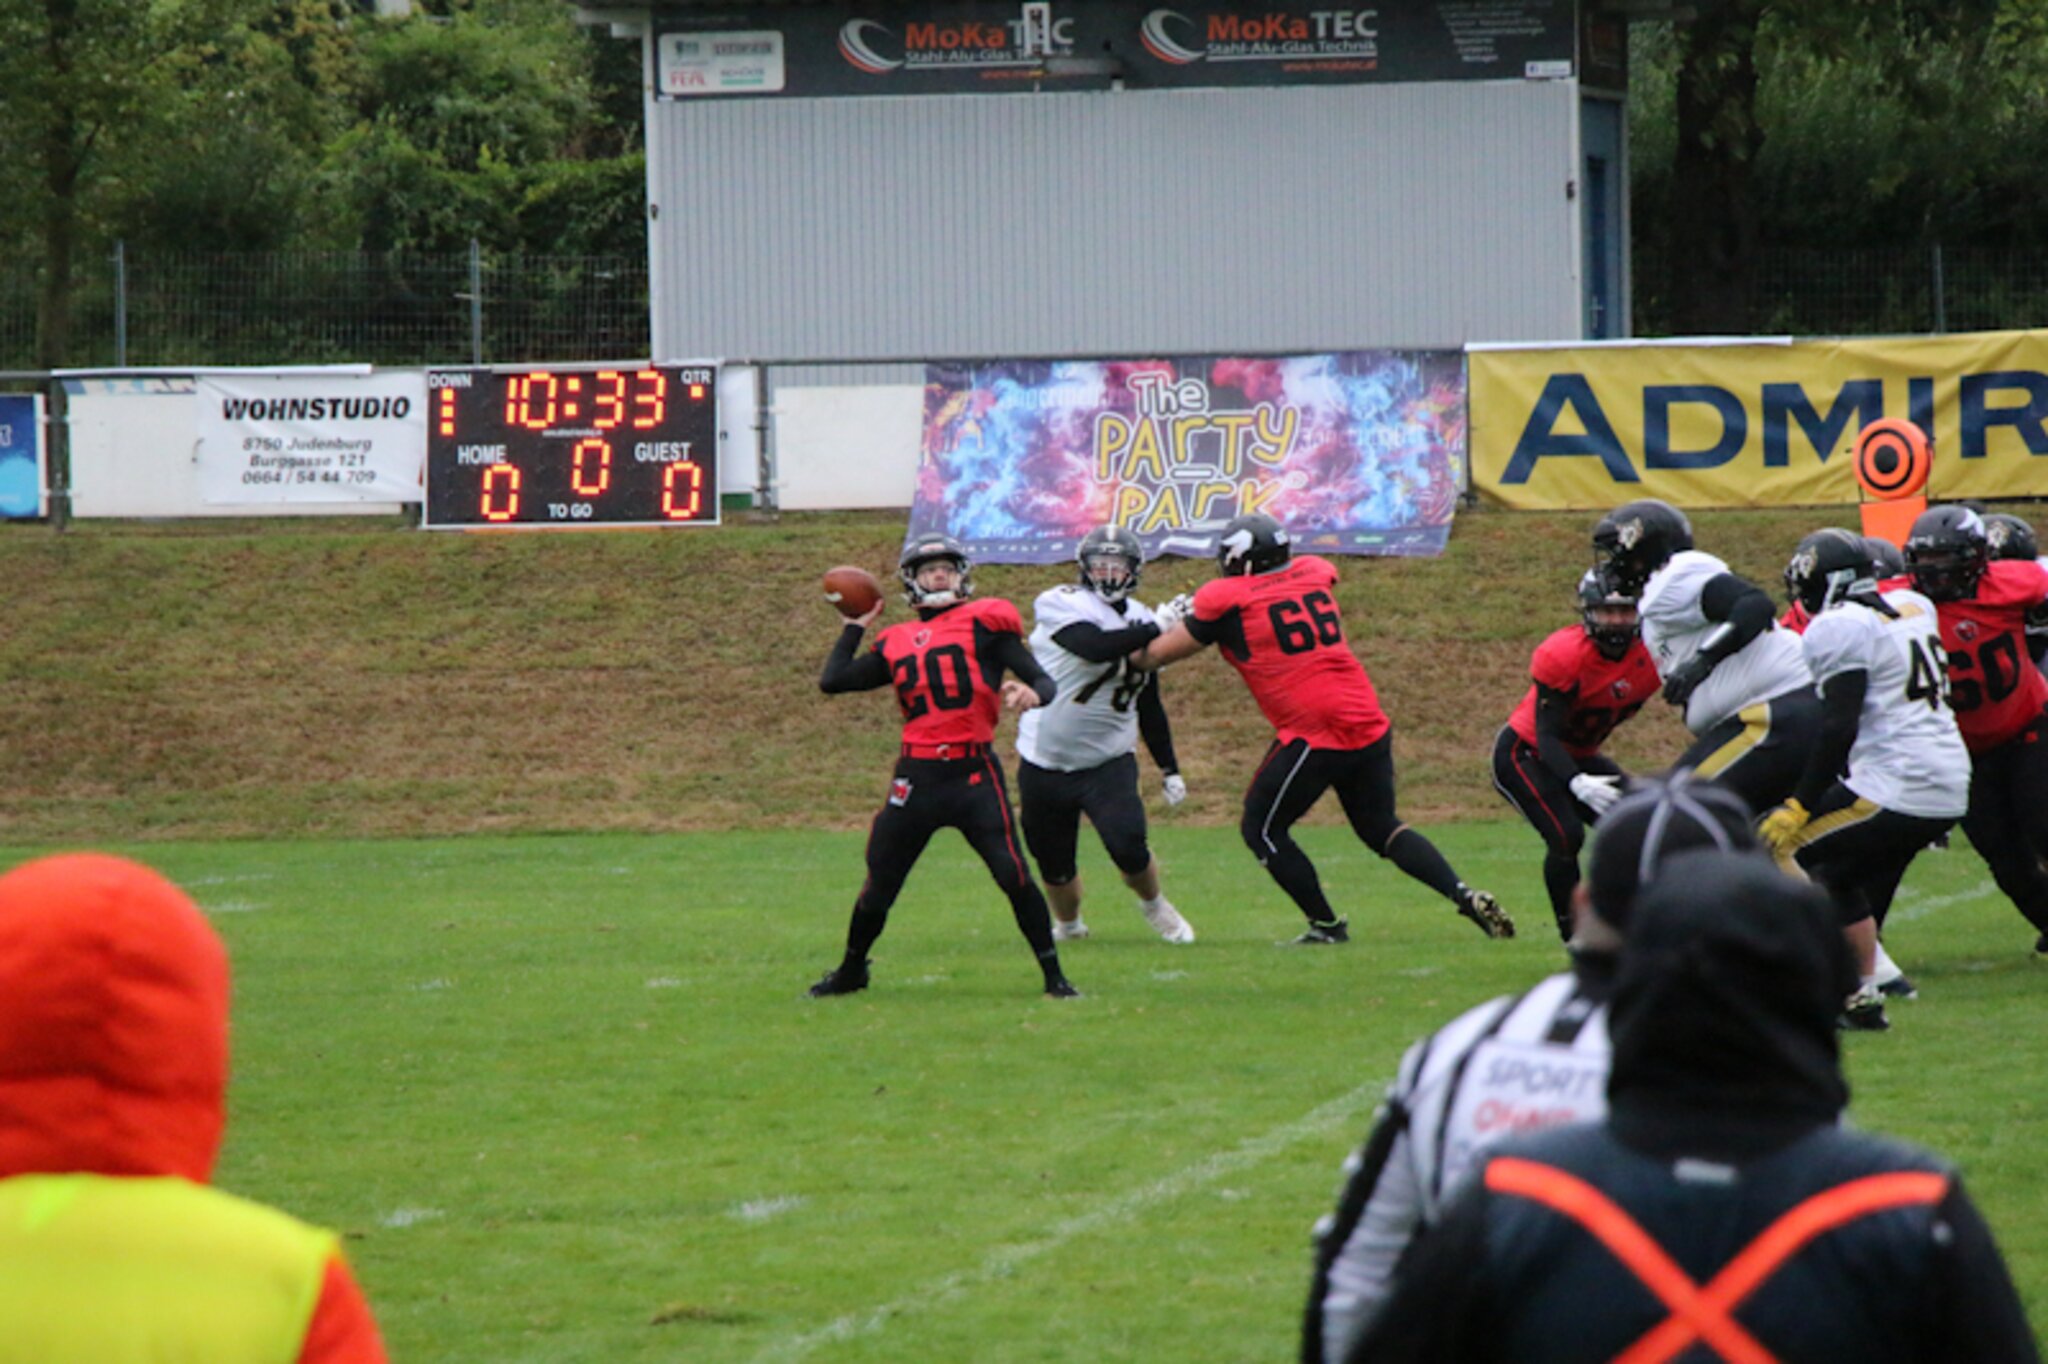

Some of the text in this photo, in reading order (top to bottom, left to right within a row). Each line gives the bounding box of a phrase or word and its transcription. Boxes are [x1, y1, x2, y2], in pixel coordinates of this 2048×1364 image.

[905, 18, 1074, 49] MoKaTC
[1319, 40, 1377, 53] Technik
[429, 373, 472, 388] DOWN
[681, 369, 711, 384] QTR
[505, 371, 666, 428] 10:33
[1130, 373, 1206, 416] The
[222, 396, 411, 421] WOHNSTUDIO
[242, 437, 373, 451] 8750 Judenburg
[457, 444, 507, 465] HOME
[634, 441, 691, 462] GUEST
[250, 453, 366, 468] Burggasse 121
[572, 438, 611, 495] 0
[242, 470, 282, 484] 0664
[296, 471, 316, 484] 54
[320, 471, 340, 483] 44
[347, 470, 377, 483] 709
[662, 461, 701, 518] 0
[481, 463, 520, 521] 0
[548, 503, 593, 518] TO GO
[1268, 589, 1342, 655] 66
[894, 643, 973, 720] 20
[1481, 1057, 1597, 1098] SPORT
